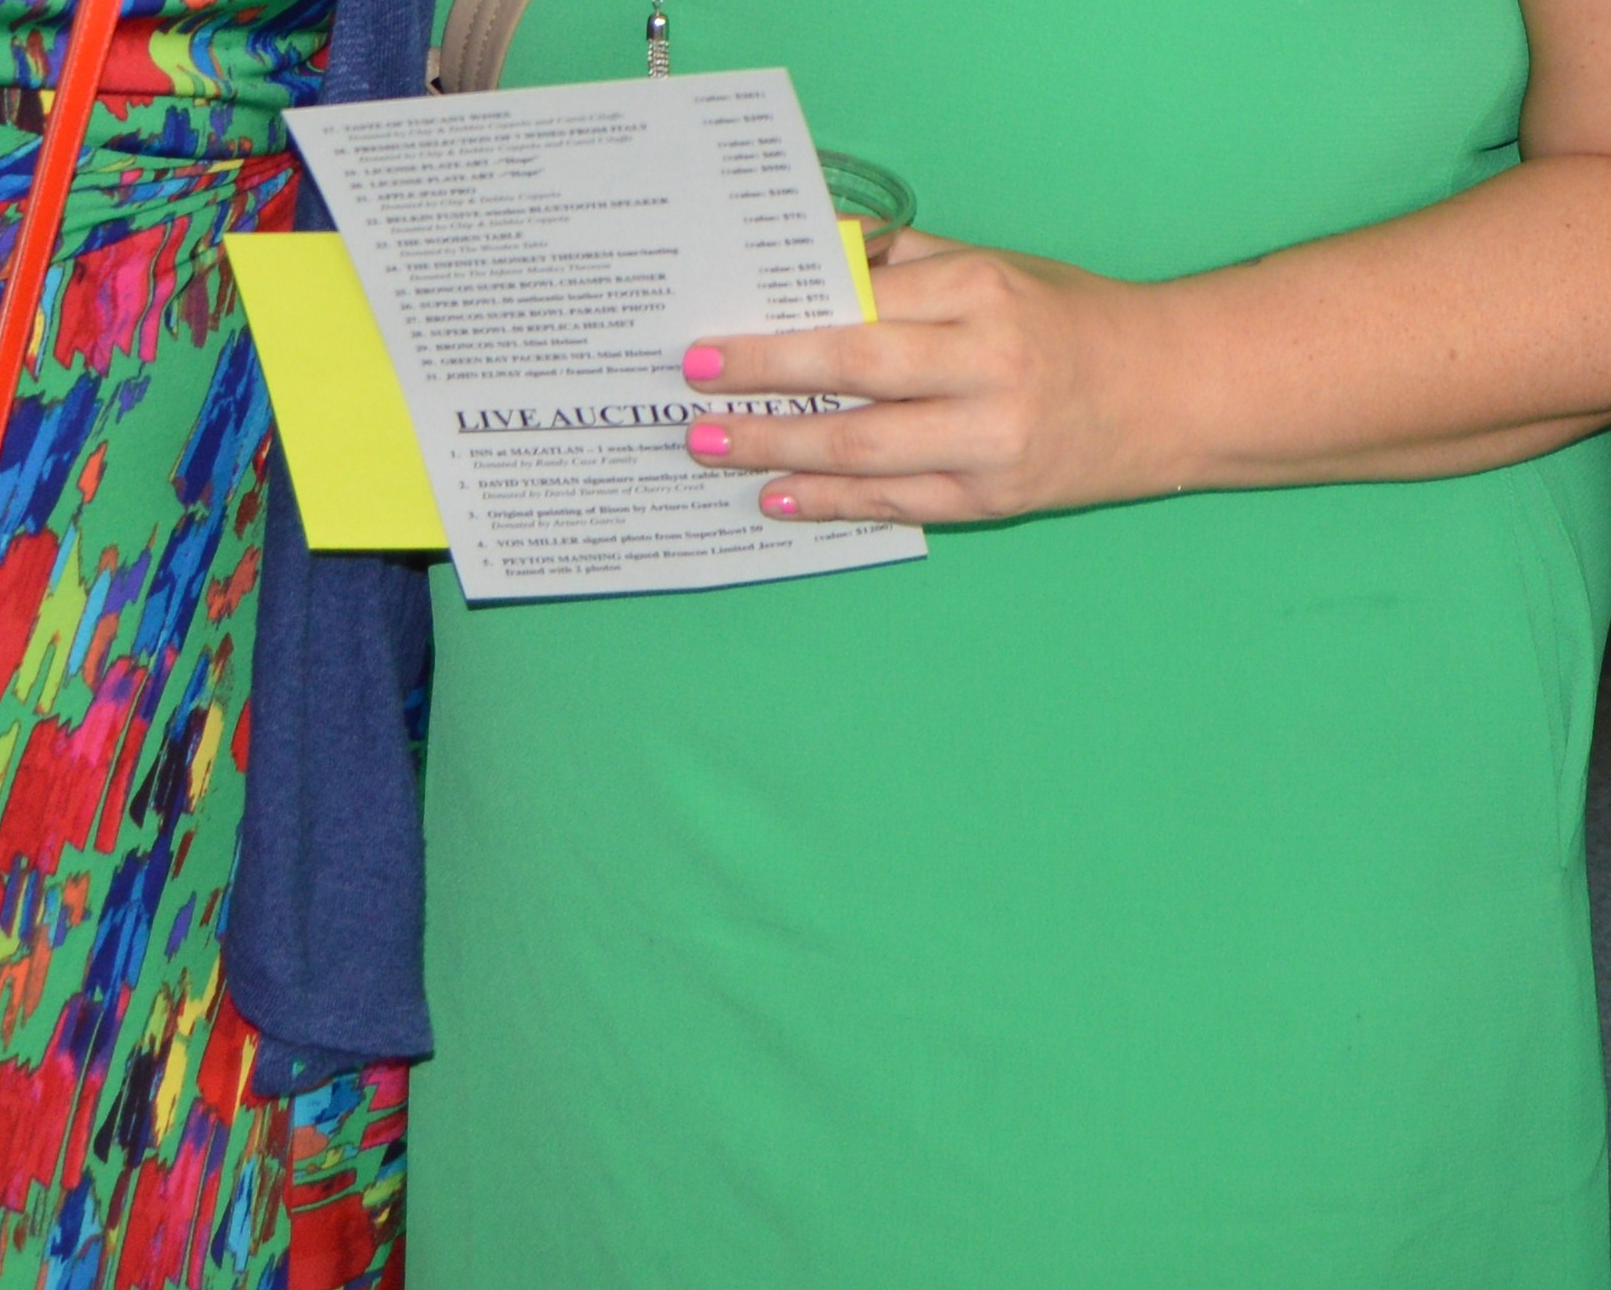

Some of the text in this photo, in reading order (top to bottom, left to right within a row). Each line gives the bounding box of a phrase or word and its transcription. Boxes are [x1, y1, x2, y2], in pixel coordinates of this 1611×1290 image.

[456, 394, 841, 430] LIVE AUCTION ITEMS
[510, 446, 583, 455] MAZATLAN
[478, 478, 519, 488] DAVID
[521, 477, 579, 486] YURMAN
[582, 476, 634, 485] signature
[487, 509, 533, 518] Original
[536, 508, 582, 518] painting
[527, 536, 578, 546] MILLER
[582, 535, 617, 545] signed
[620, 534, 652, 543] photo
[501, 556, 554, 565] PEYTON
[557, 553, 621, 562] MANNING
[624, 551, 659, 560] signed
[710, 543, 754, 554] Limited
